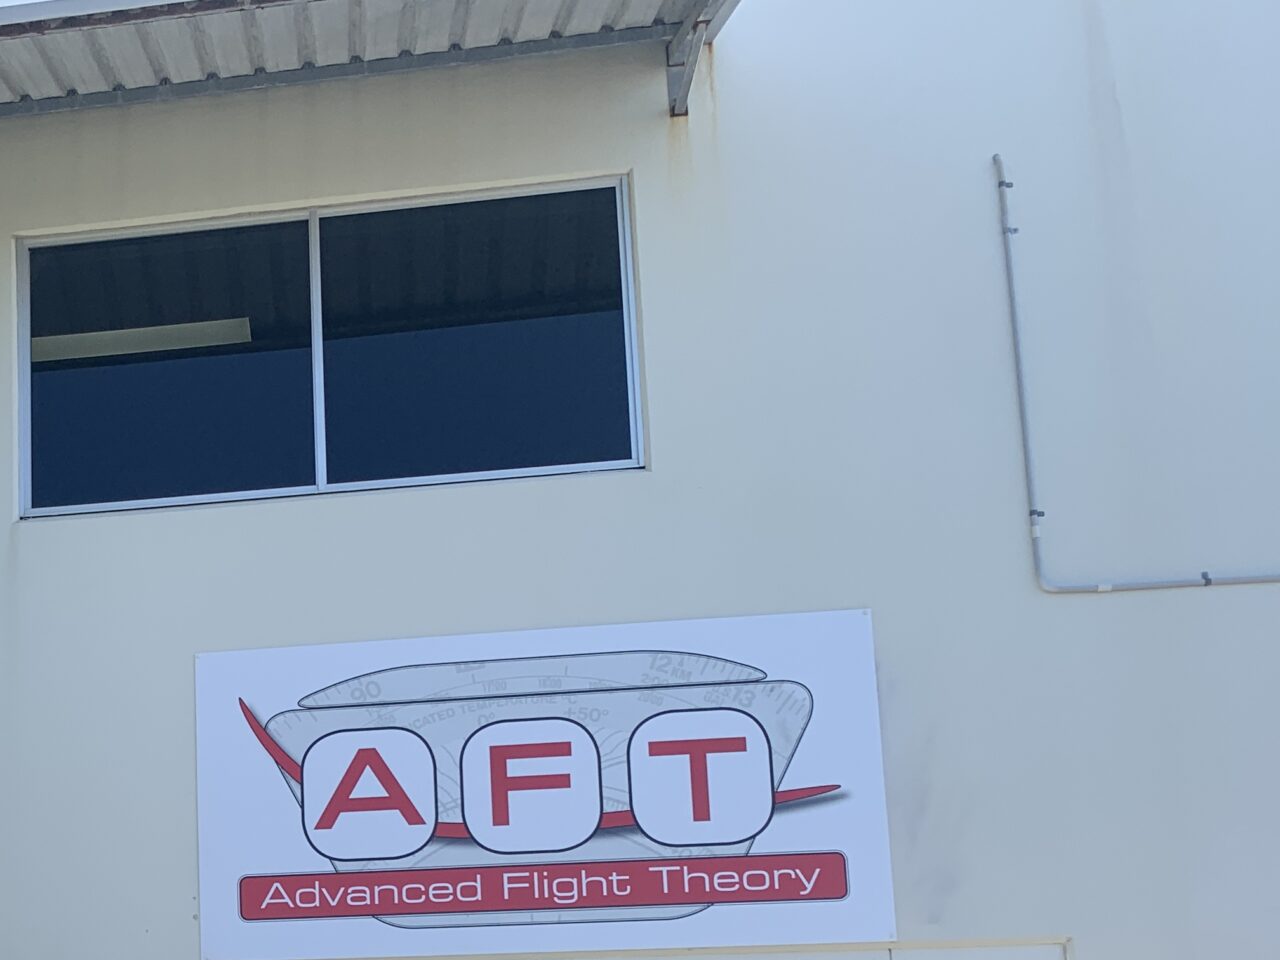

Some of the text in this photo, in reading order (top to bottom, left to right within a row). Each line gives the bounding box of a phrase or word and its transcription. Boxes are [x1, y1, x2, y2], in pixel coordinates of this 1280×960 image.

[261, 863, 821, 909] Advanced Flight Theory
